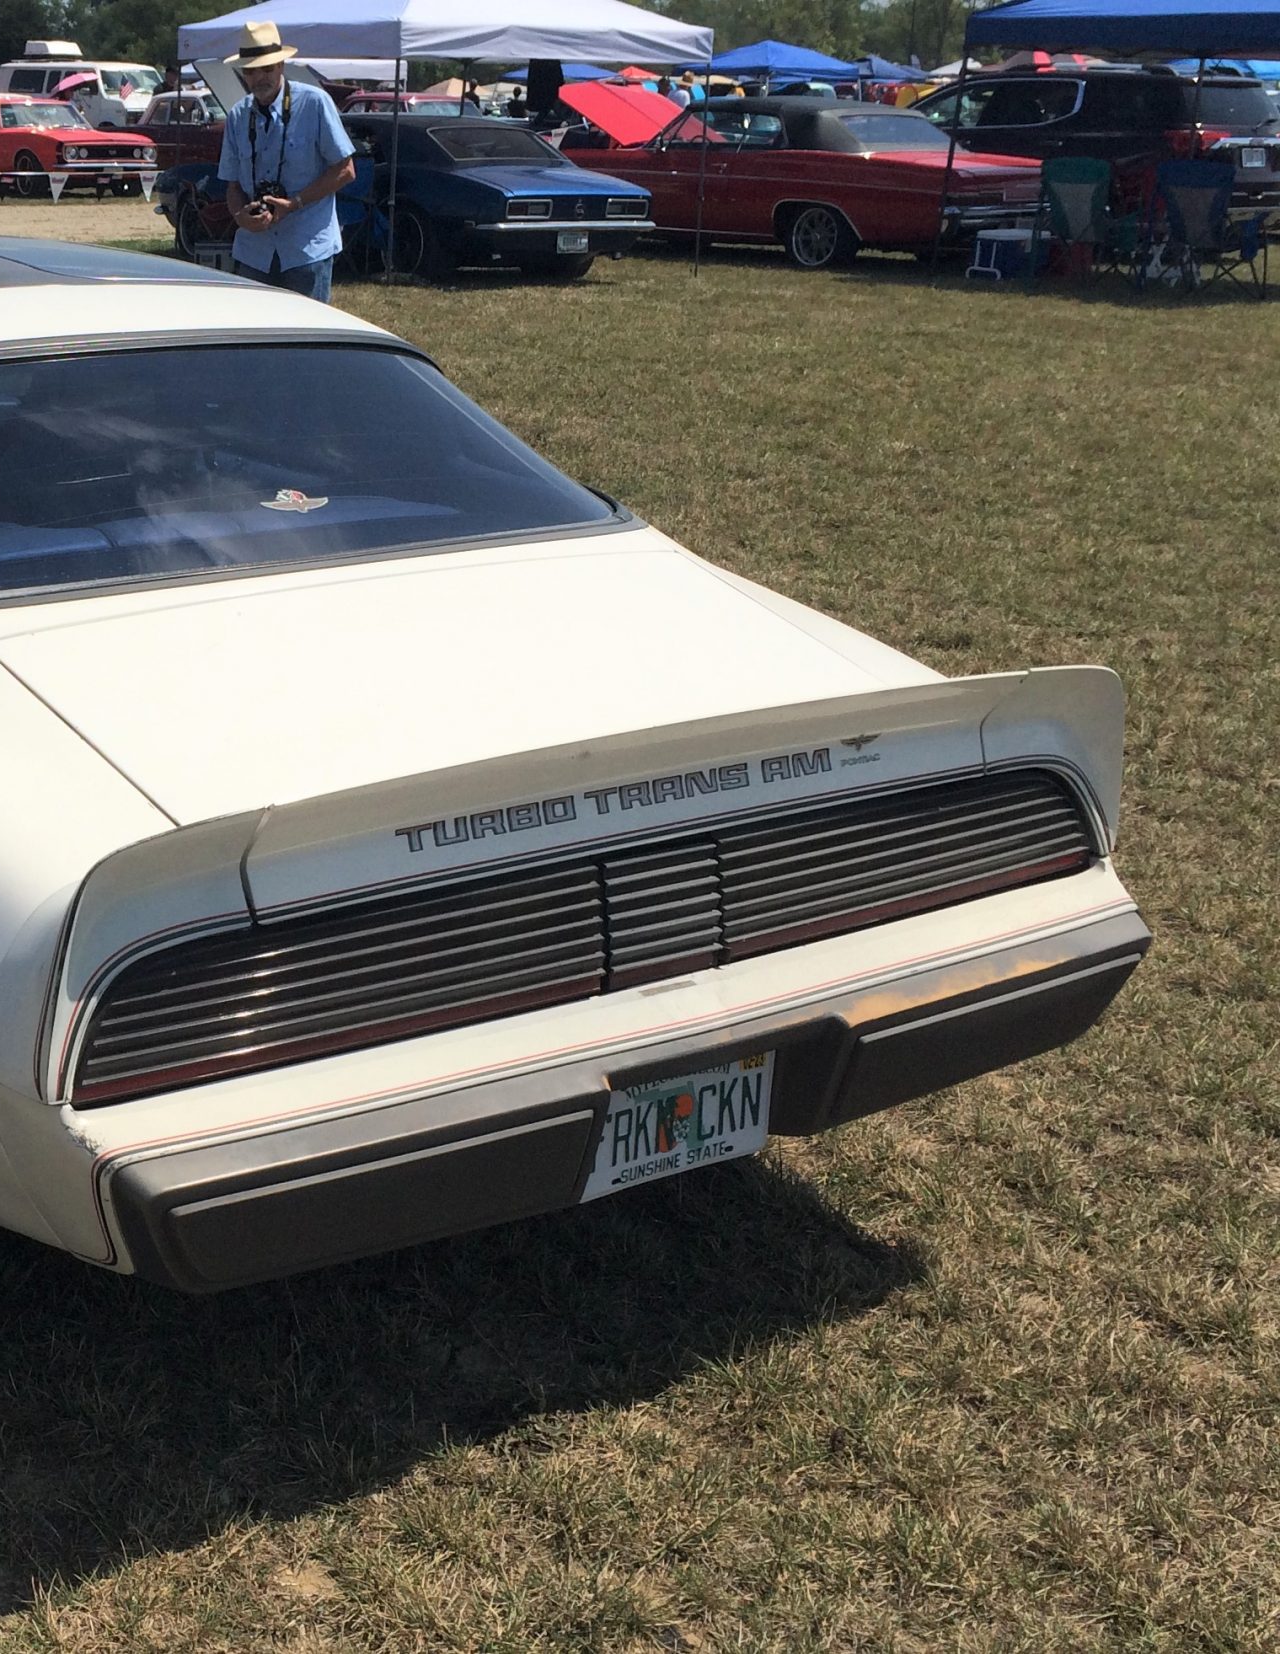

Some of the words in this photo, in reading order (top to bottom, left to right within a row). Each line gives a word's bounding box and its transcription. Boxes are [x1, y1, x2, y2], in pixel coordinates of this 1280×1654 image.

[395, 795, 577, 852] TURBO
[584, 762, 750, 815] TRANS
[761, 748, 832, 784] AM
[600, 1094, 678, 1167] RKN
[620, 1153, 681, 1184] SUNSHINE
[686, 1140, 726, 1166] STATE
